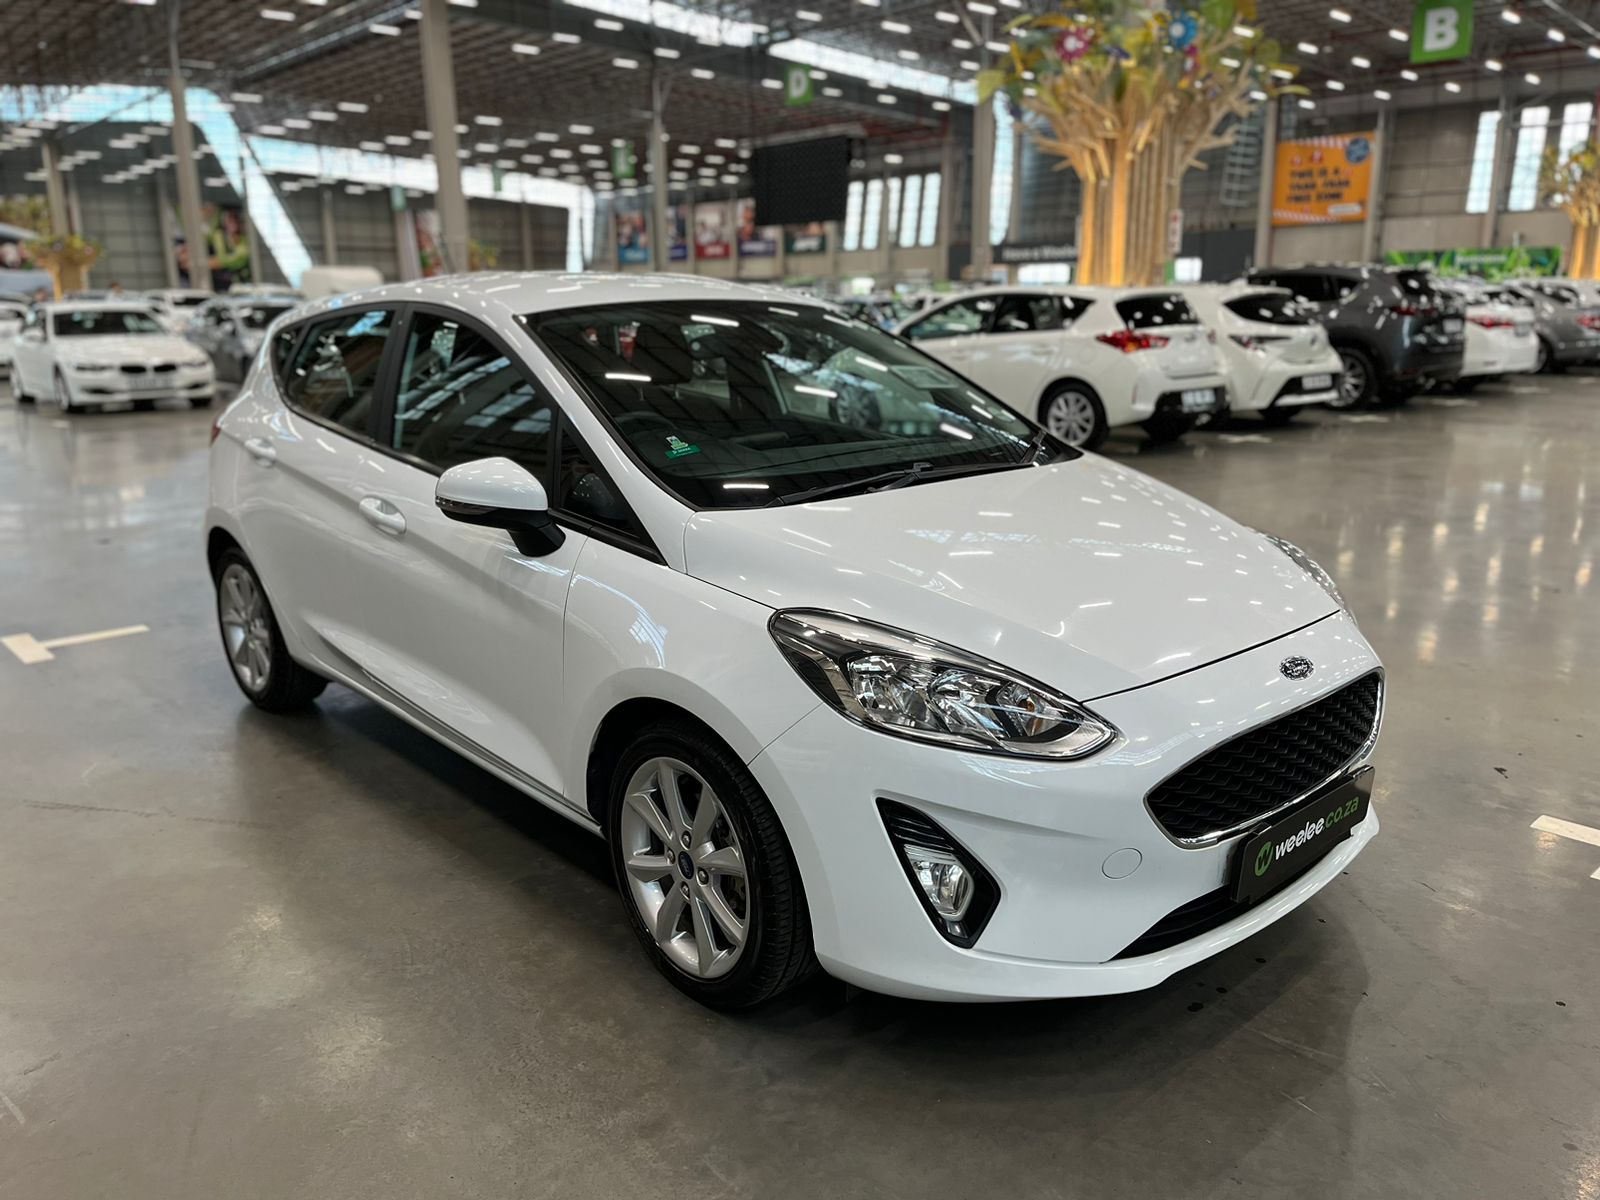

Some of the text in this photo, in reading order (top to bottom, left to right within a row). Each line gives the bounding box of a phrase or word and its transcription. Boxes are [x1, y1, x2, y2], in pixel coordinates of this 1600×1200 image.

[1424, 7, 1459, 51] B
[789, 69, 808, 98] D
[1275, 796, 1360, 861] weelee.co.za
